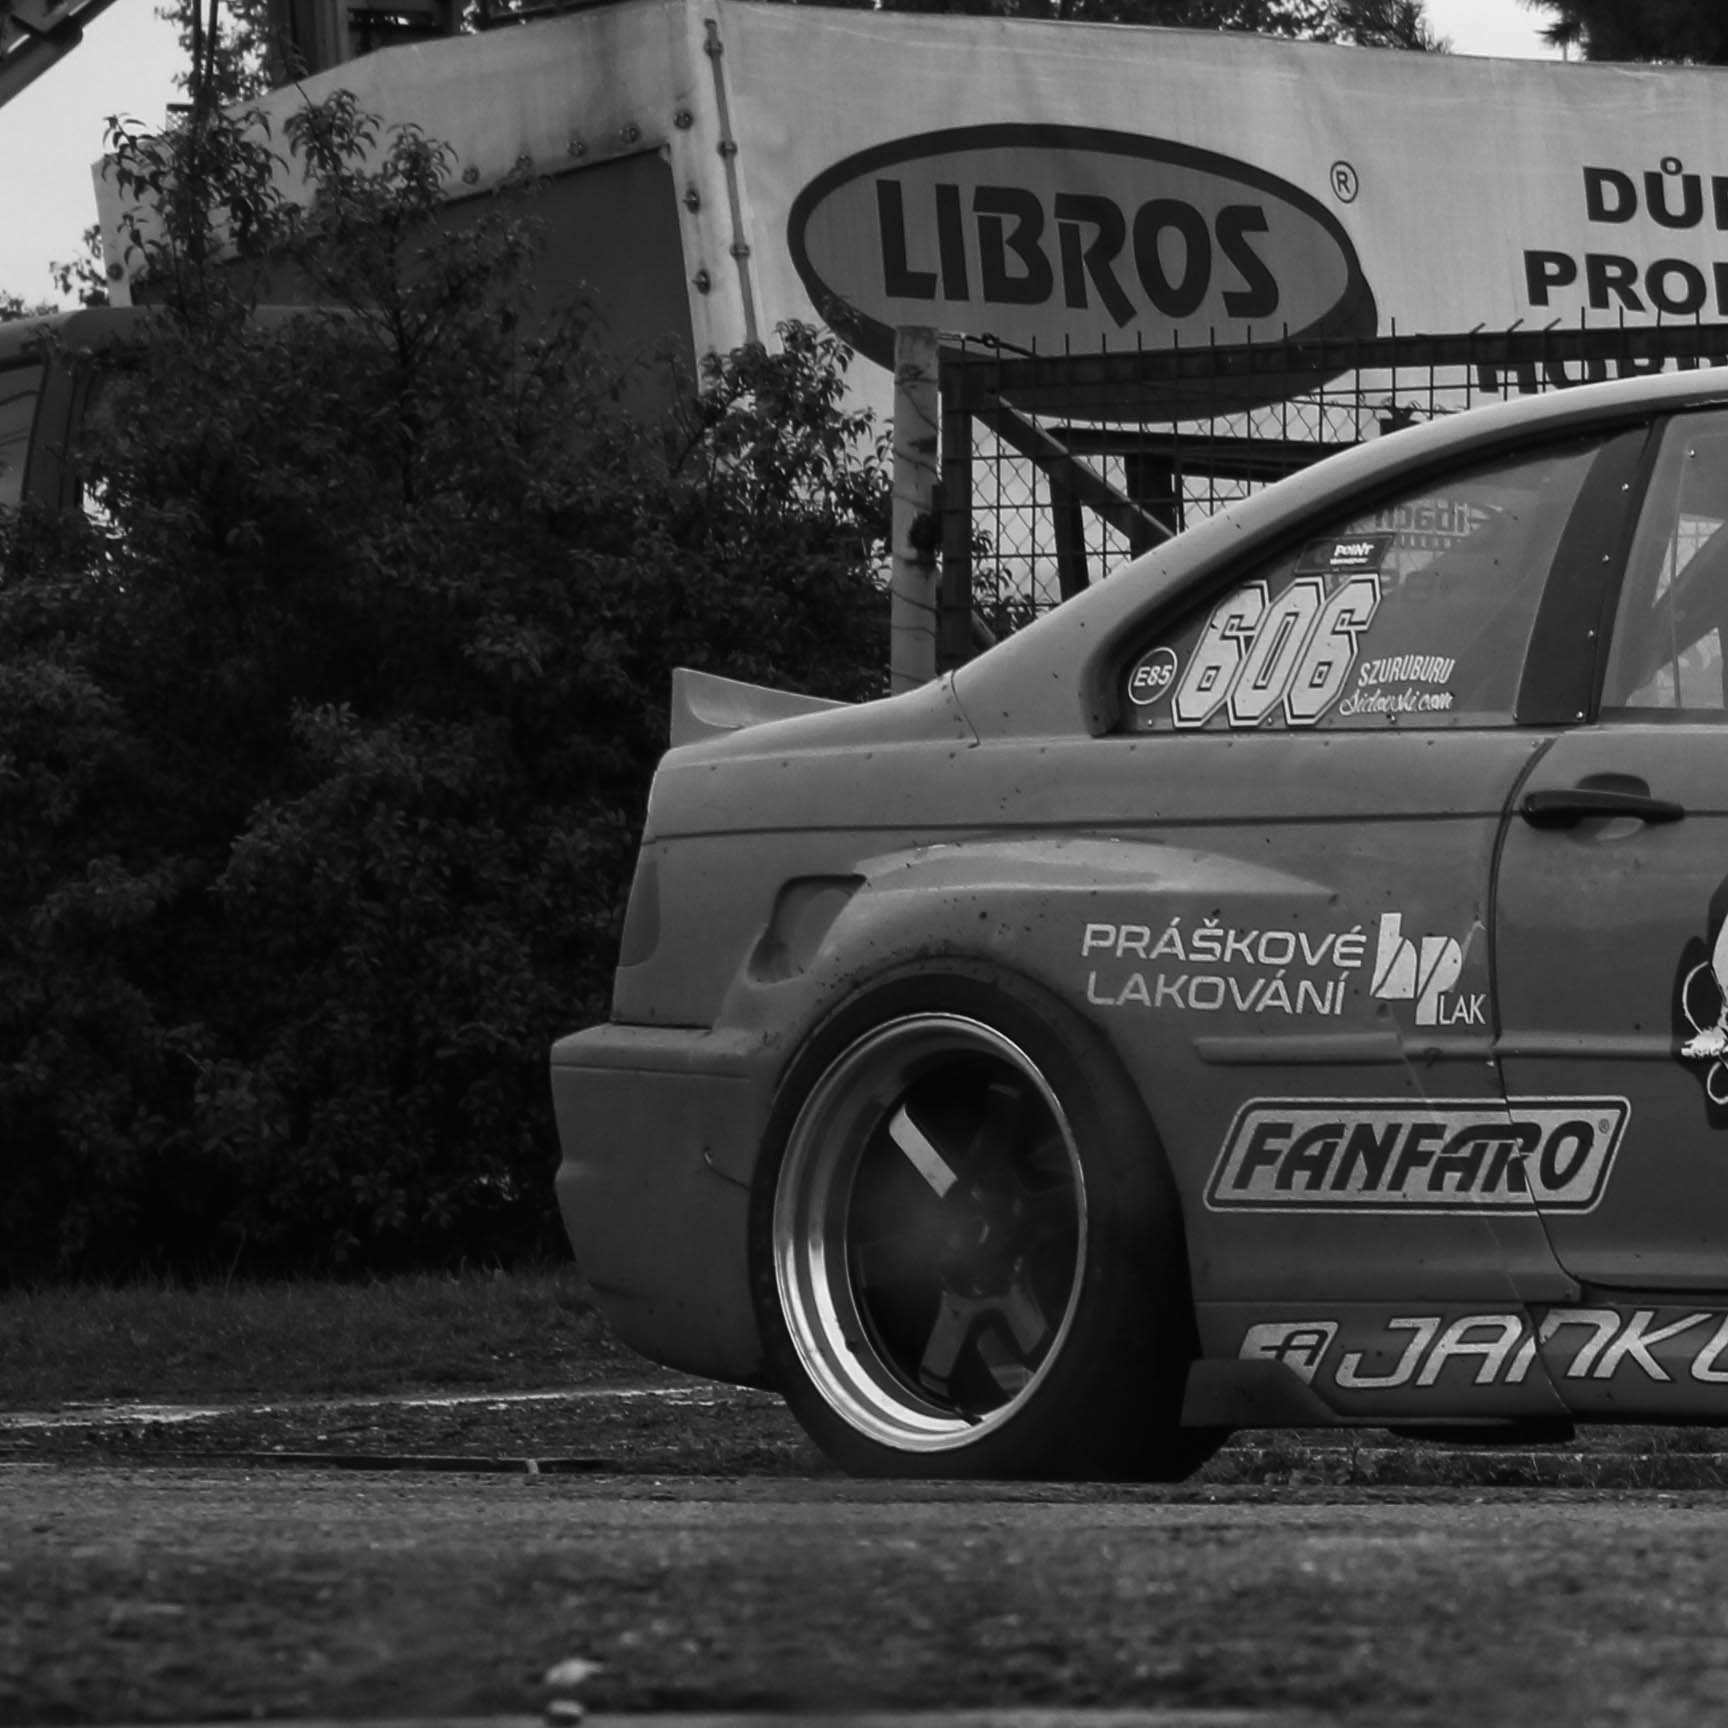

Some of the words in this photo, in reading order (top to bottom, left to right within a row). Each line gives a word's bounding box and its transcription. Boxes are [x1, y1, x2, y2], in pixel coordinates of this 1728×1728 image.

[876, 178, 1280, 329] LIBROS
[1171, 572, 1382, 728] 606
[1357, 653, 1456, 687] SZURUBURU
[1133, 663, 1173, 688] E85
[1081, 916, 1367, 967] PRÁŠKOVÉ
[1086, 968, 1350, 1016] LAKOVÁNÍ
[1439, 993, 1486, 1025] LAK
[1231, 1119, 1596, 1193] FANFARO
